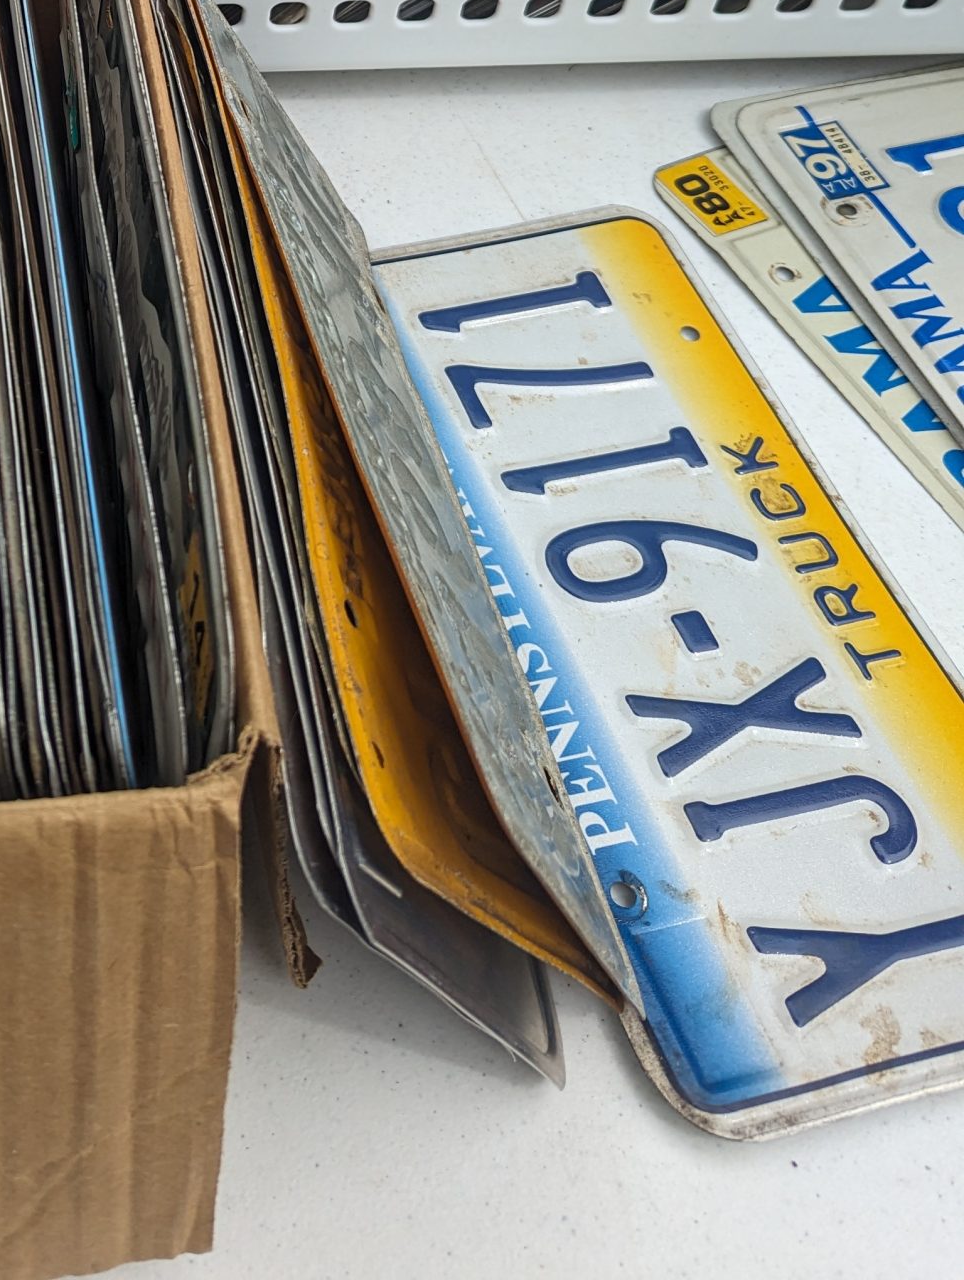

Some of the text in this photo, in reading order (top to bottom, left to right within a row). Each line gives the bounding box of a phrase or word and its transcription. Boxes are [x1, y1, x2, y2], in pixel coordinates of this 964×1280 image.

[697, 164, 730, 193] 33020
[784, 130, 837, 186] 97
[673, 172, 724, 217] 80
[821, 176, 858, 194] ALA
[712, 207, 747, 229] ALA
[719, 434, 903, 684] TRUCK
[417, 269, 964, 1029] YJX-9171
